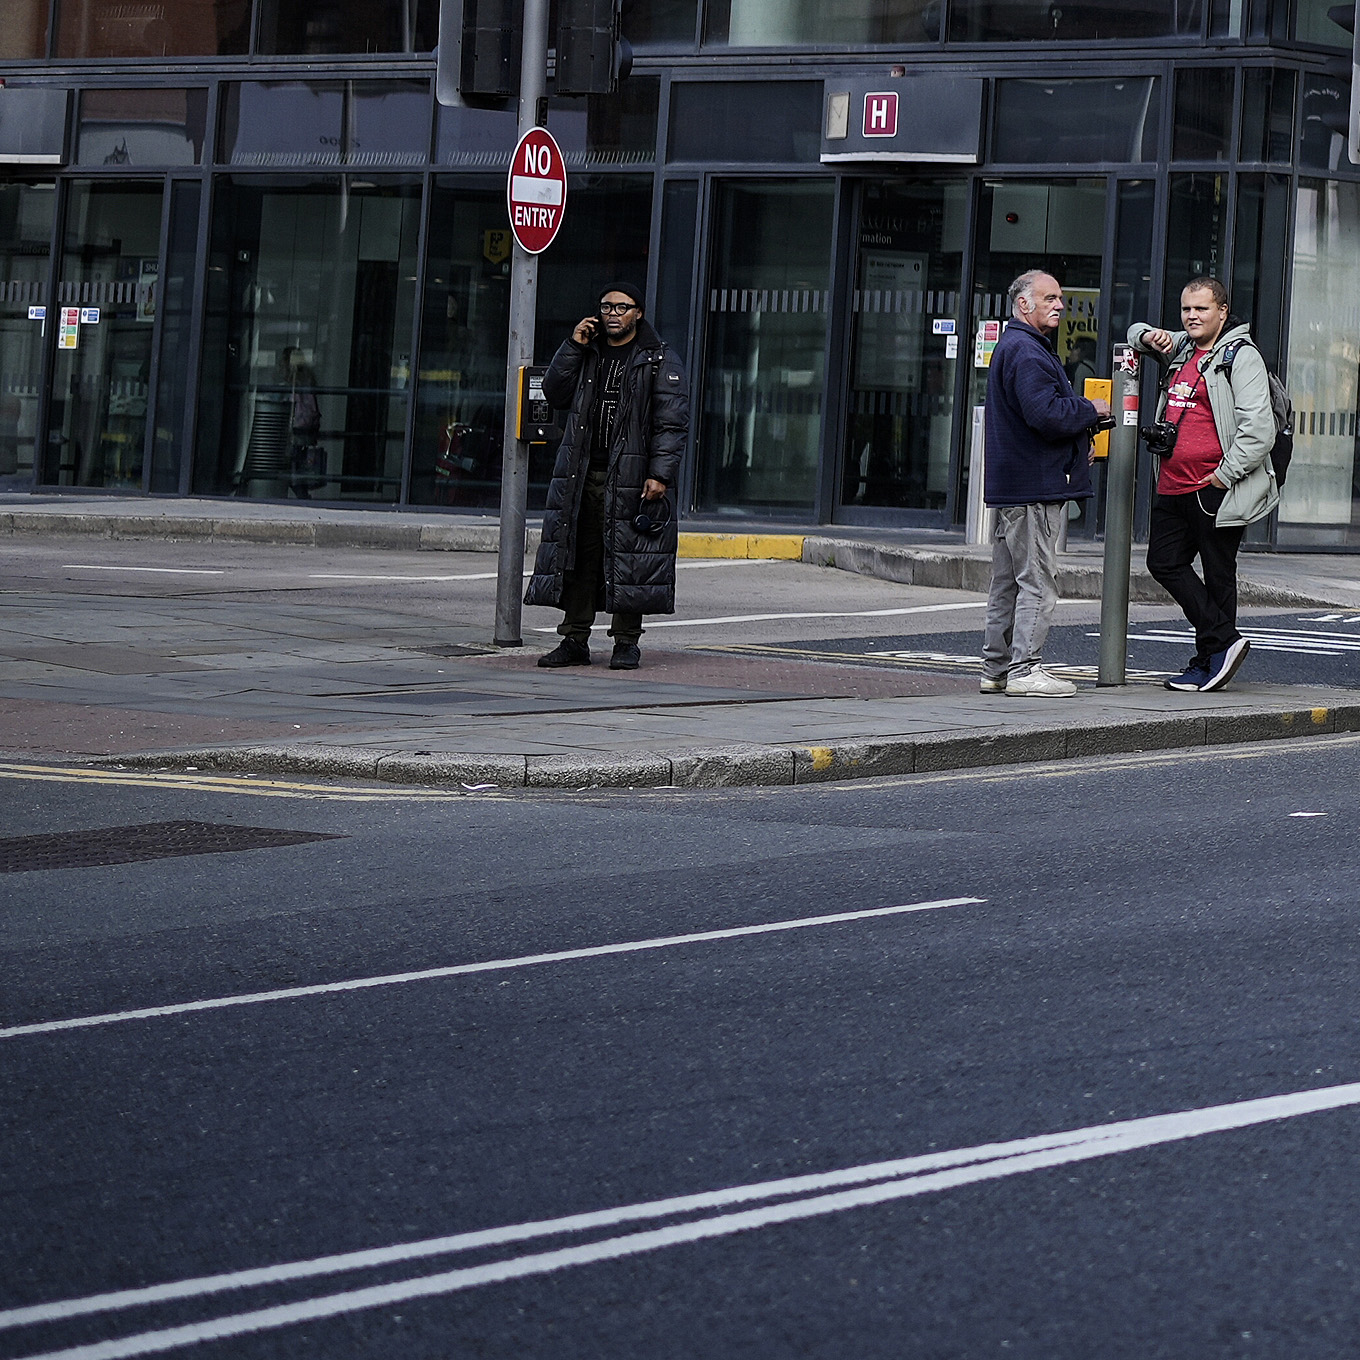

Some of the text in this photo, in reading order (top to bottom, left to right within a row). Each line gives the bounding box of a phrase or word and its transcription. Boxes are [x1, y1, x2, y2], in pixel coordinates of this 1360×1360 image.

[871, 99, 888, 129] H
[524, 143, 552, 176] NO
[514, 205, 556, 229] ENTRY
